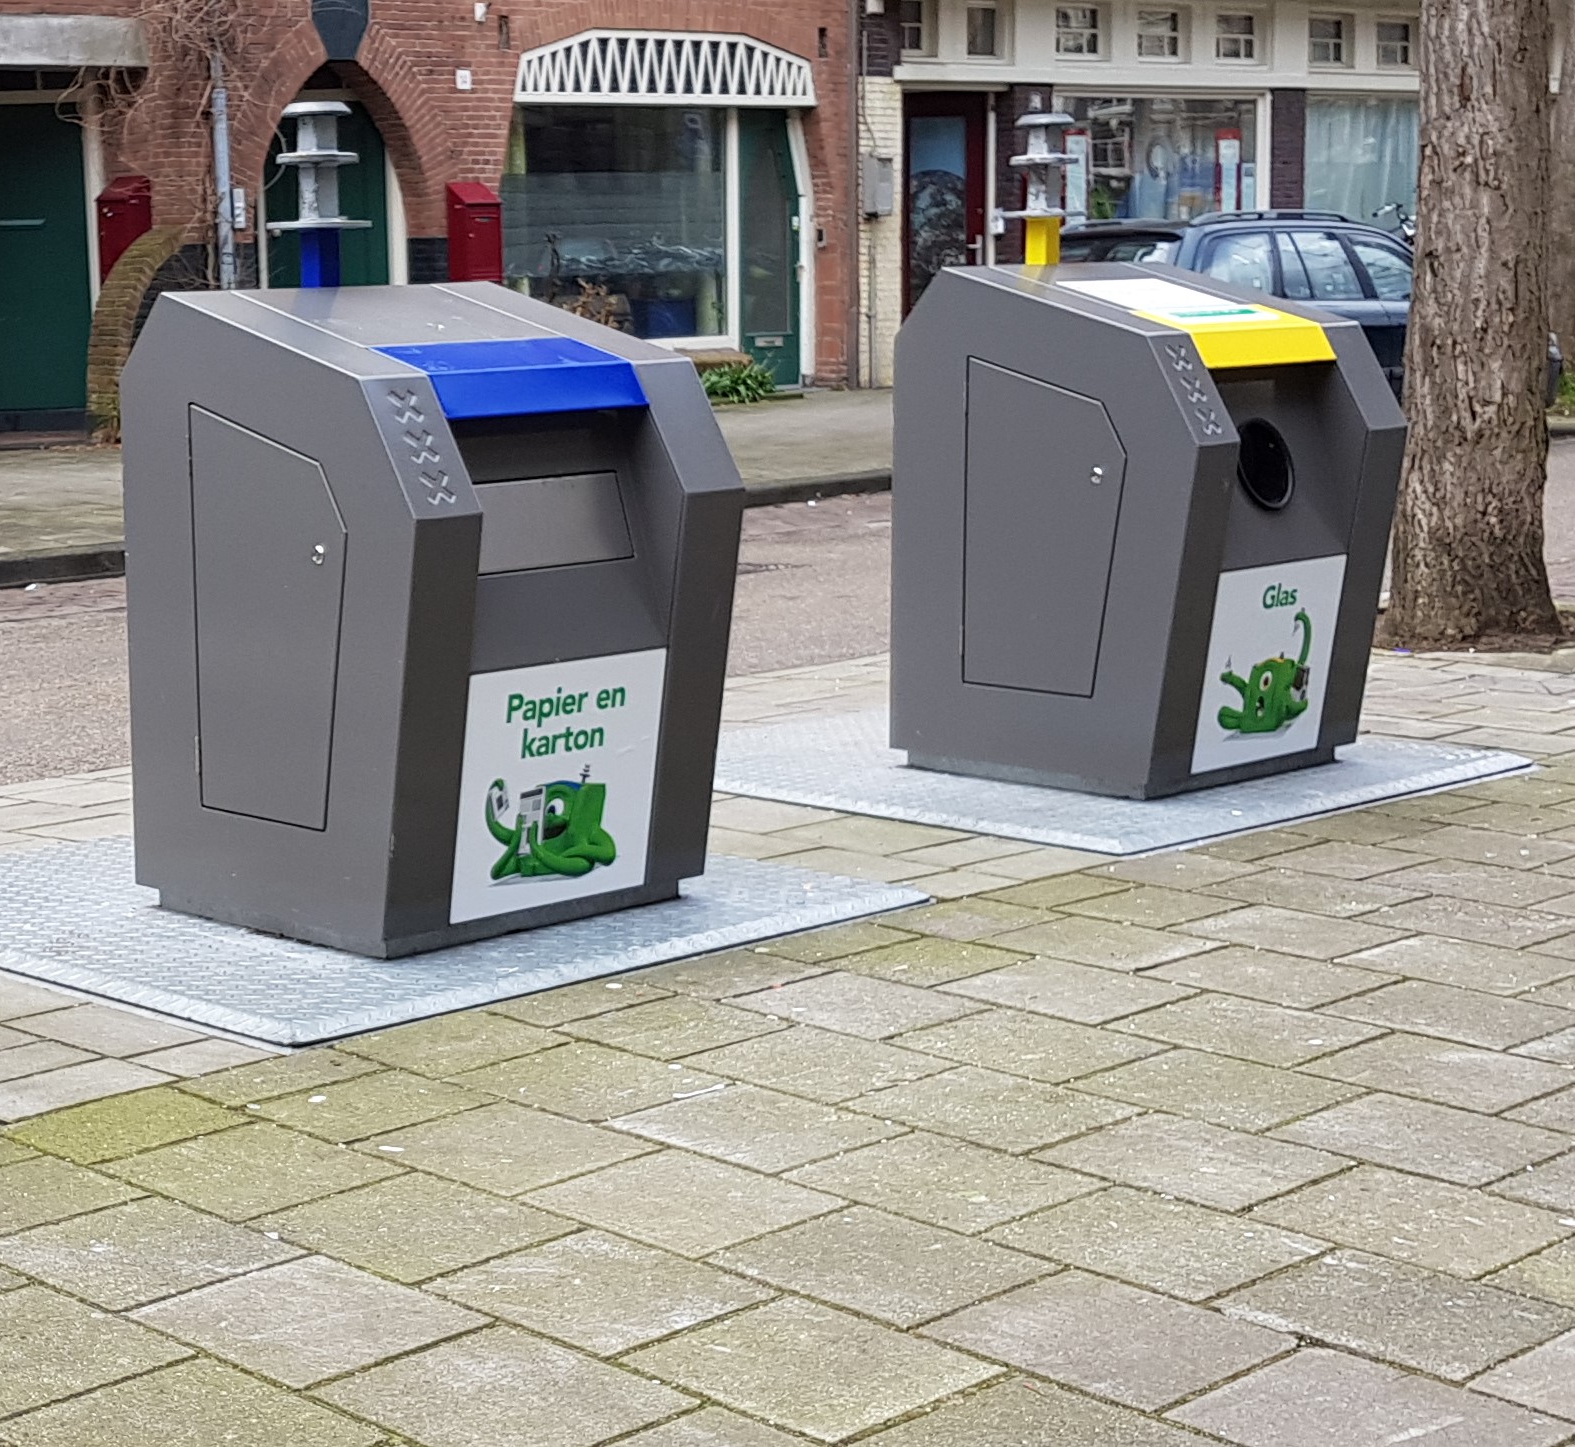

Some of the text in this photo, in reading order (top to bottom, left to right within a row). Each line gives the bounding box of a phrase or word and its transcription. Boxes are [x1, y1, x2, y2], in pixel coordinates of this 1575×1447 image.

[1262, 582, 1298, 609] Glas
[506, 686, 626, 728] Papier en
[521, 727, 604, 759] karton
